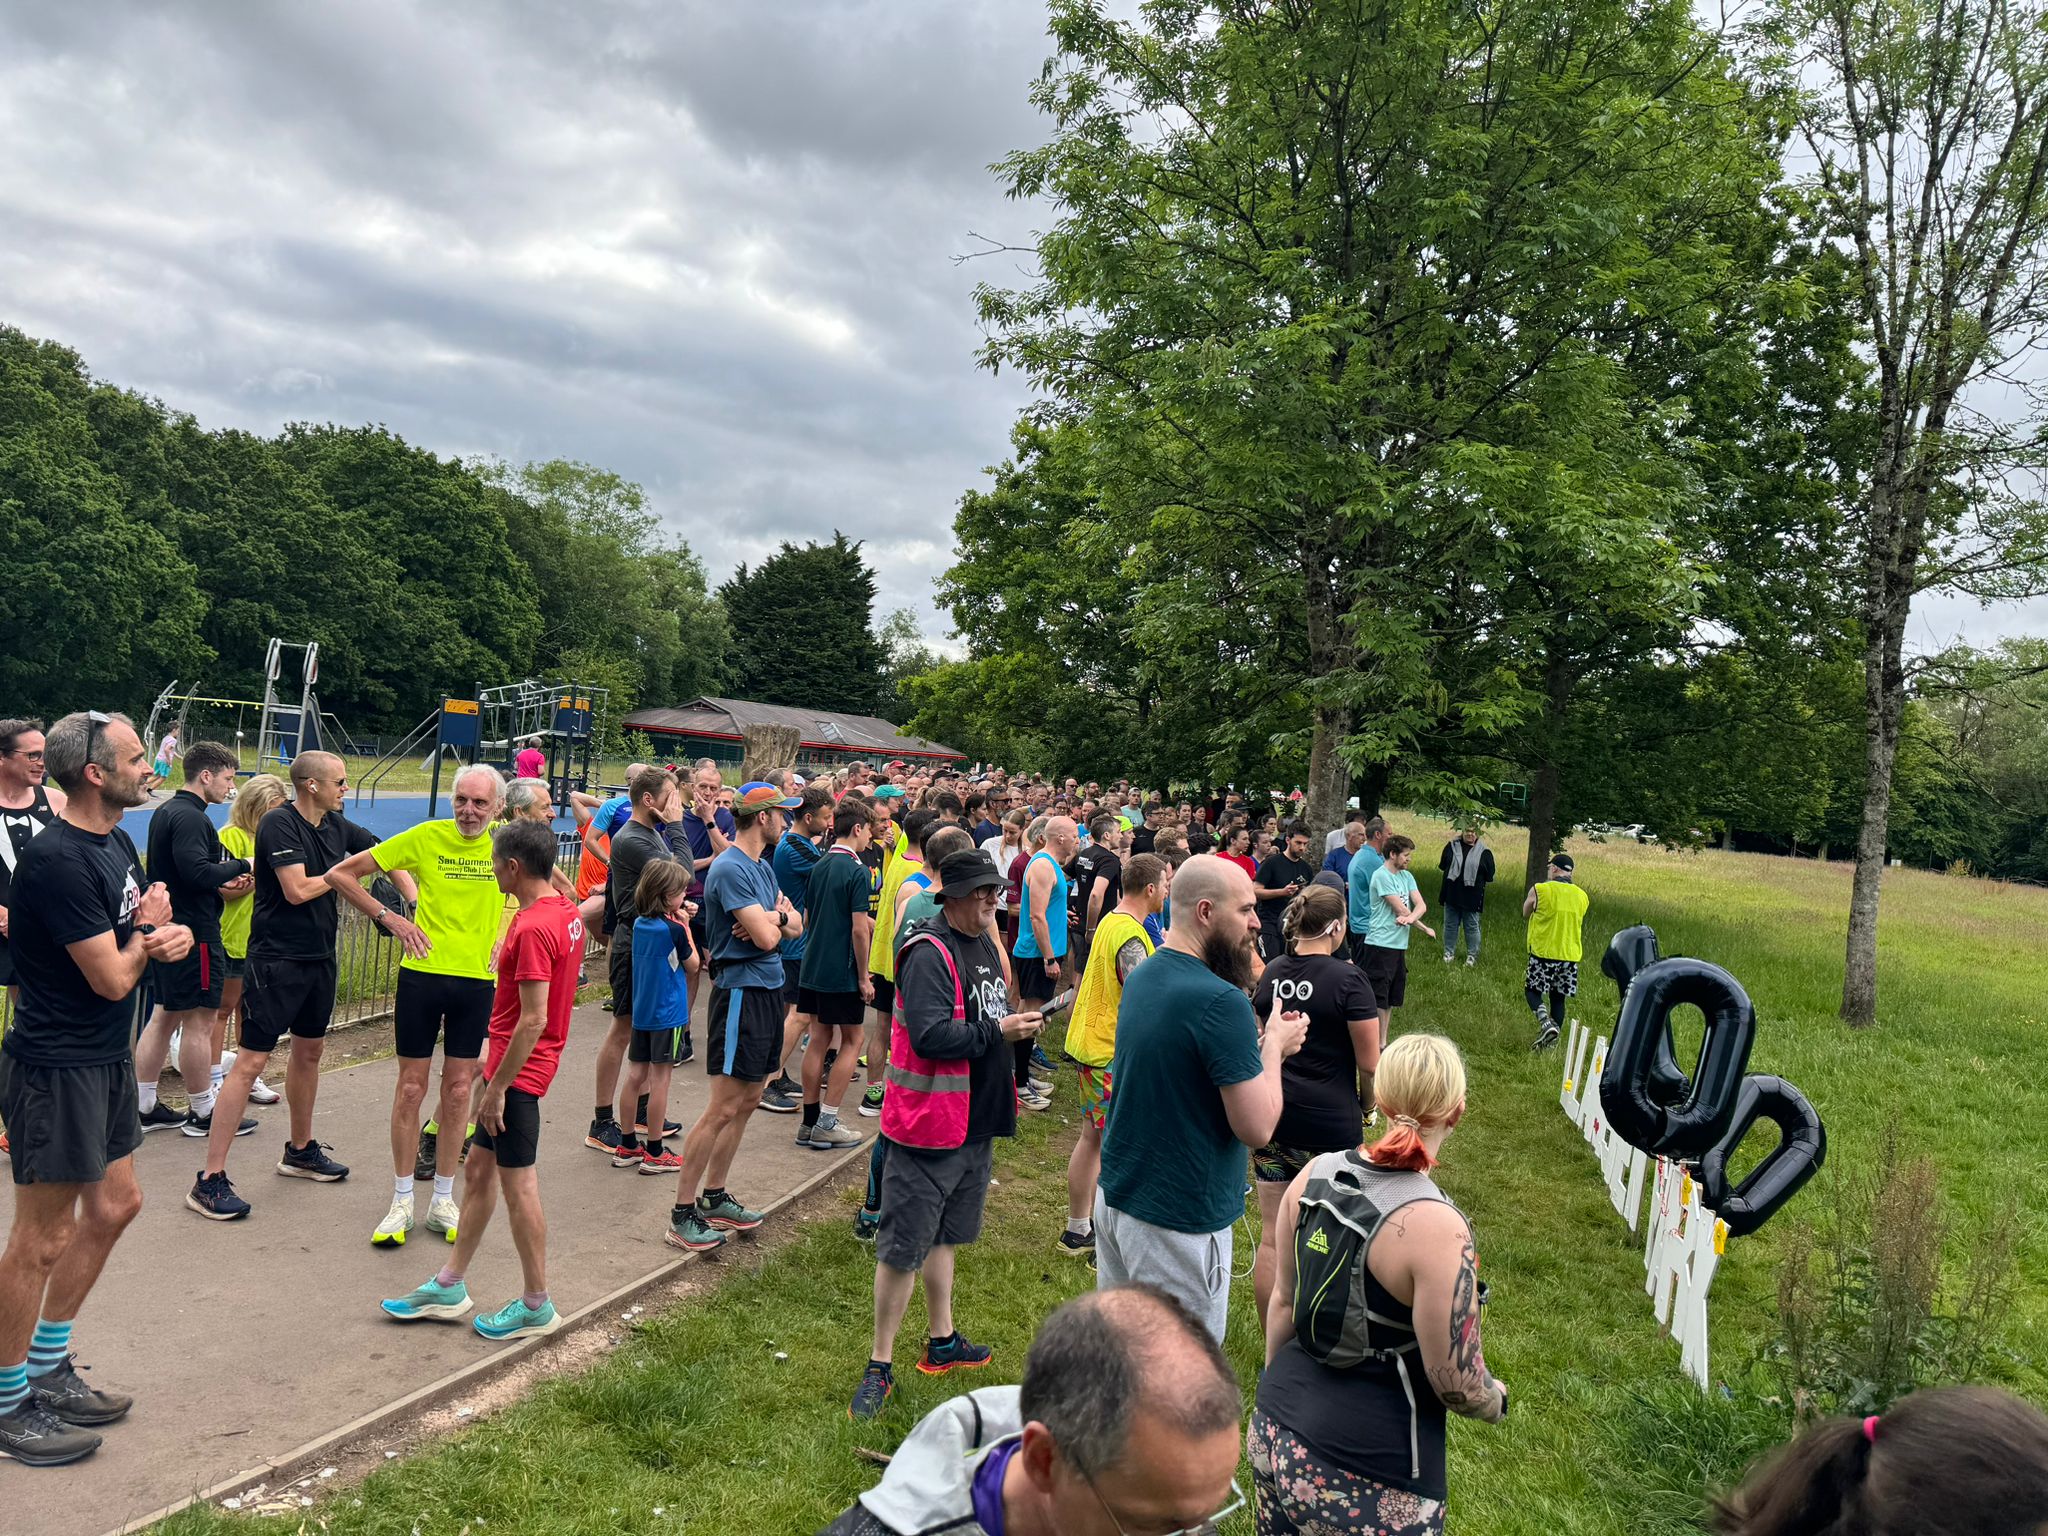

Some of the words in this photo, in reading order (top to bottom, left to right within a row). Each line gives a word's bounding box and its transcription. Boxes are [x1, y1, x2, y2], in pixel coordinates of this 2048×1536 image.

[438, 855, 456, 865] San
[459, 857, 492, 867] Domeni
[437, 865, 463, 873] Running
[1271, 978, 1314, 1001] 100
